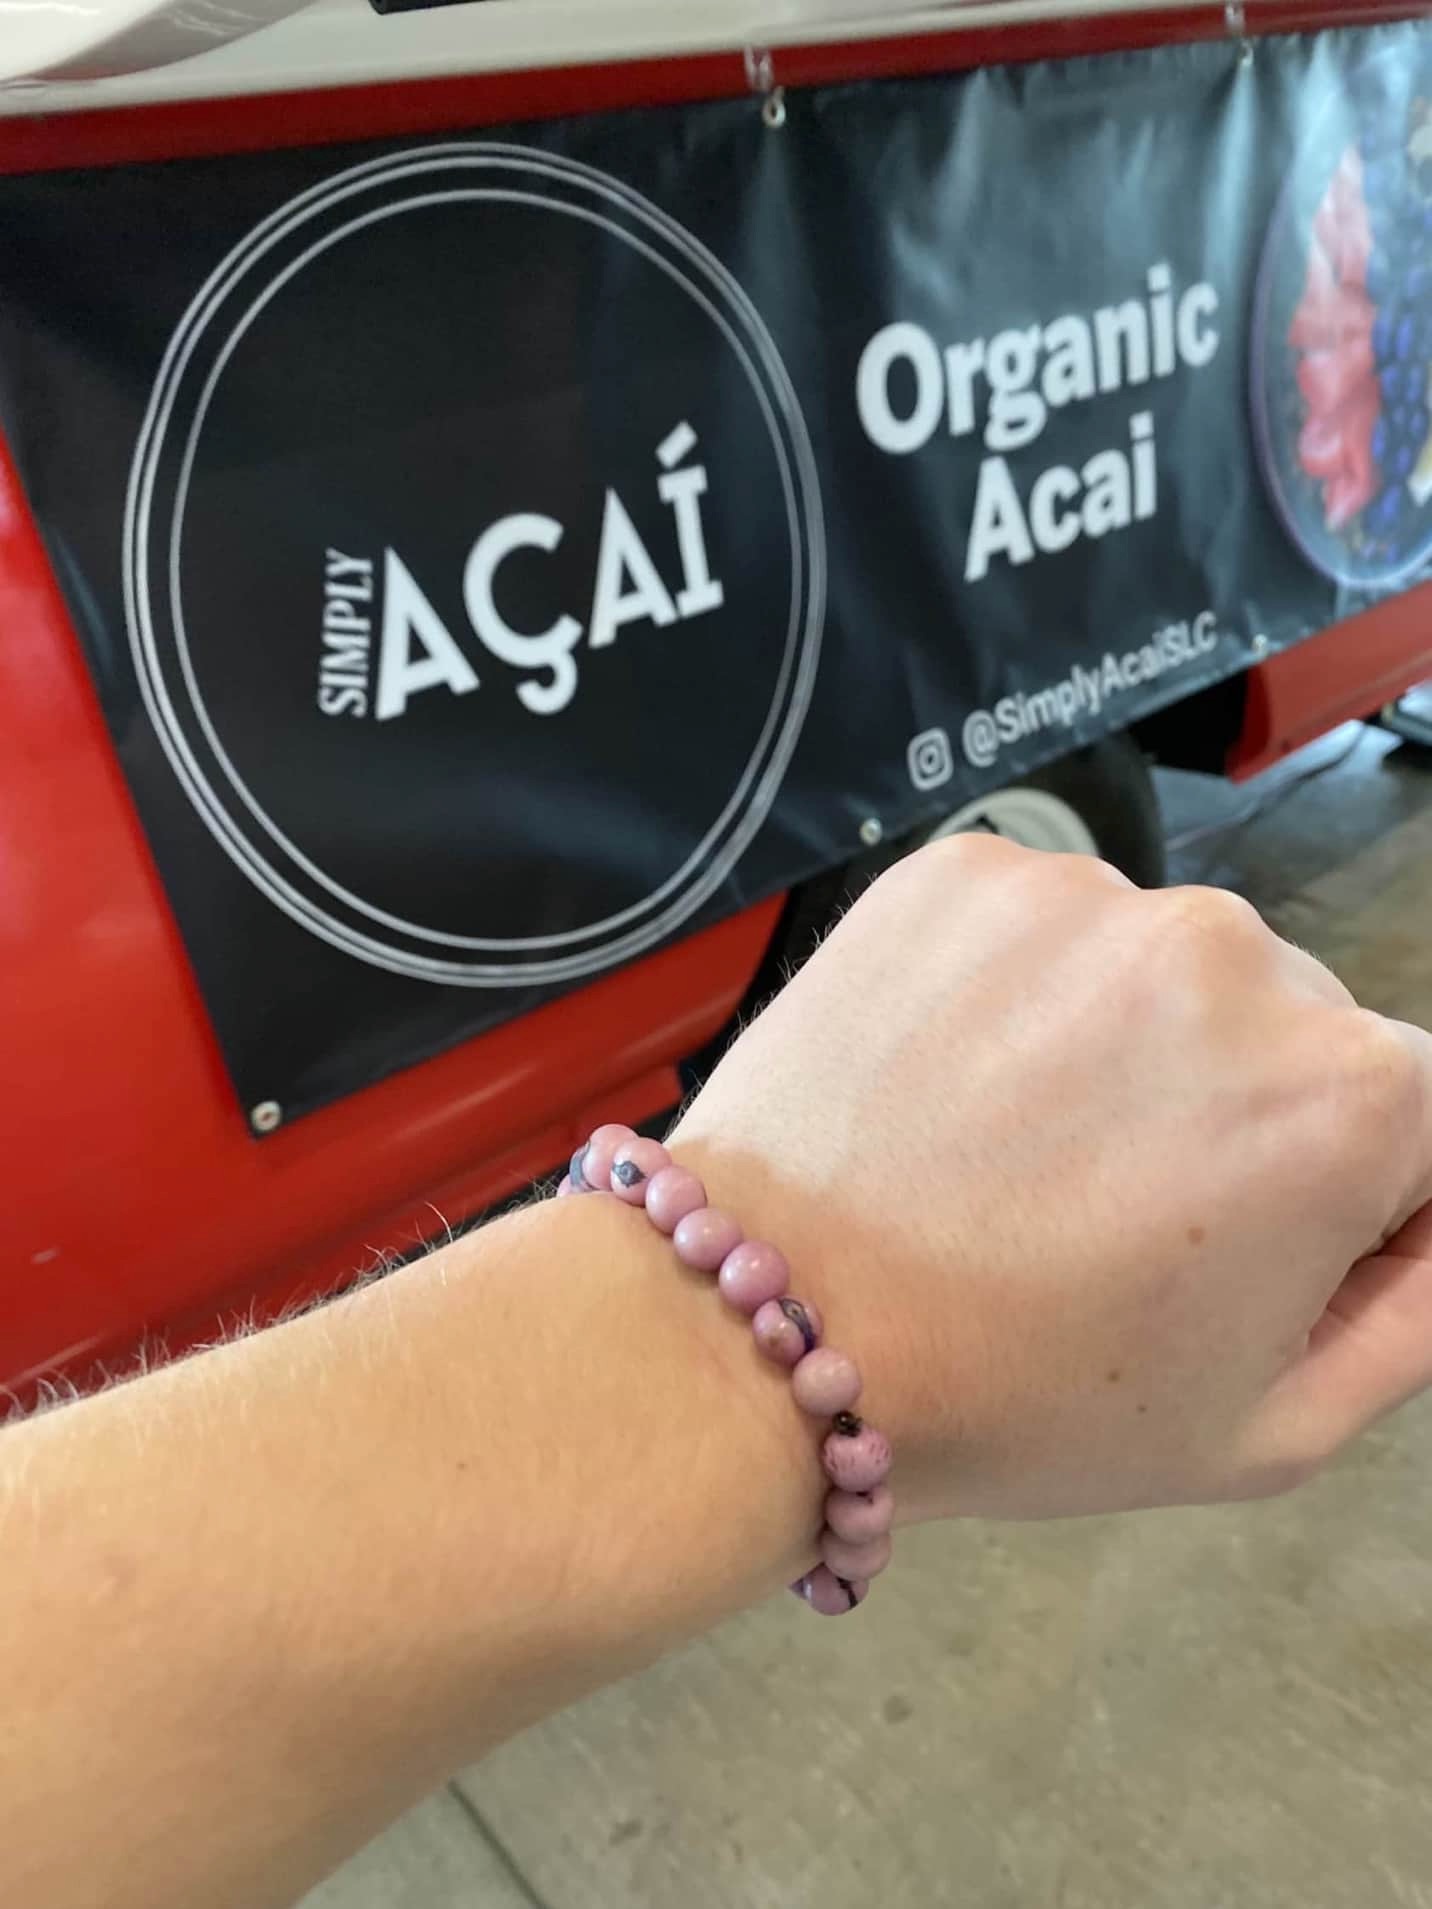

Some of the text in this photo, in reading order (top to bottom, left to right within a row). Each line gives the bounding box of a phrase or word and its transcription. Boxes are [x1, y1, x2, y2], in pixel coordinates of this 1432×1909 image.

[856, 262, 1219, 455] Organic
[375, 420, 724, 722] AÇAÍ
[964, 409, 1157, 583] Acai
[318, 547, 373, 718] SIMPLY
[962, 610, 1218, 768] @SimplyAcaiSLC
